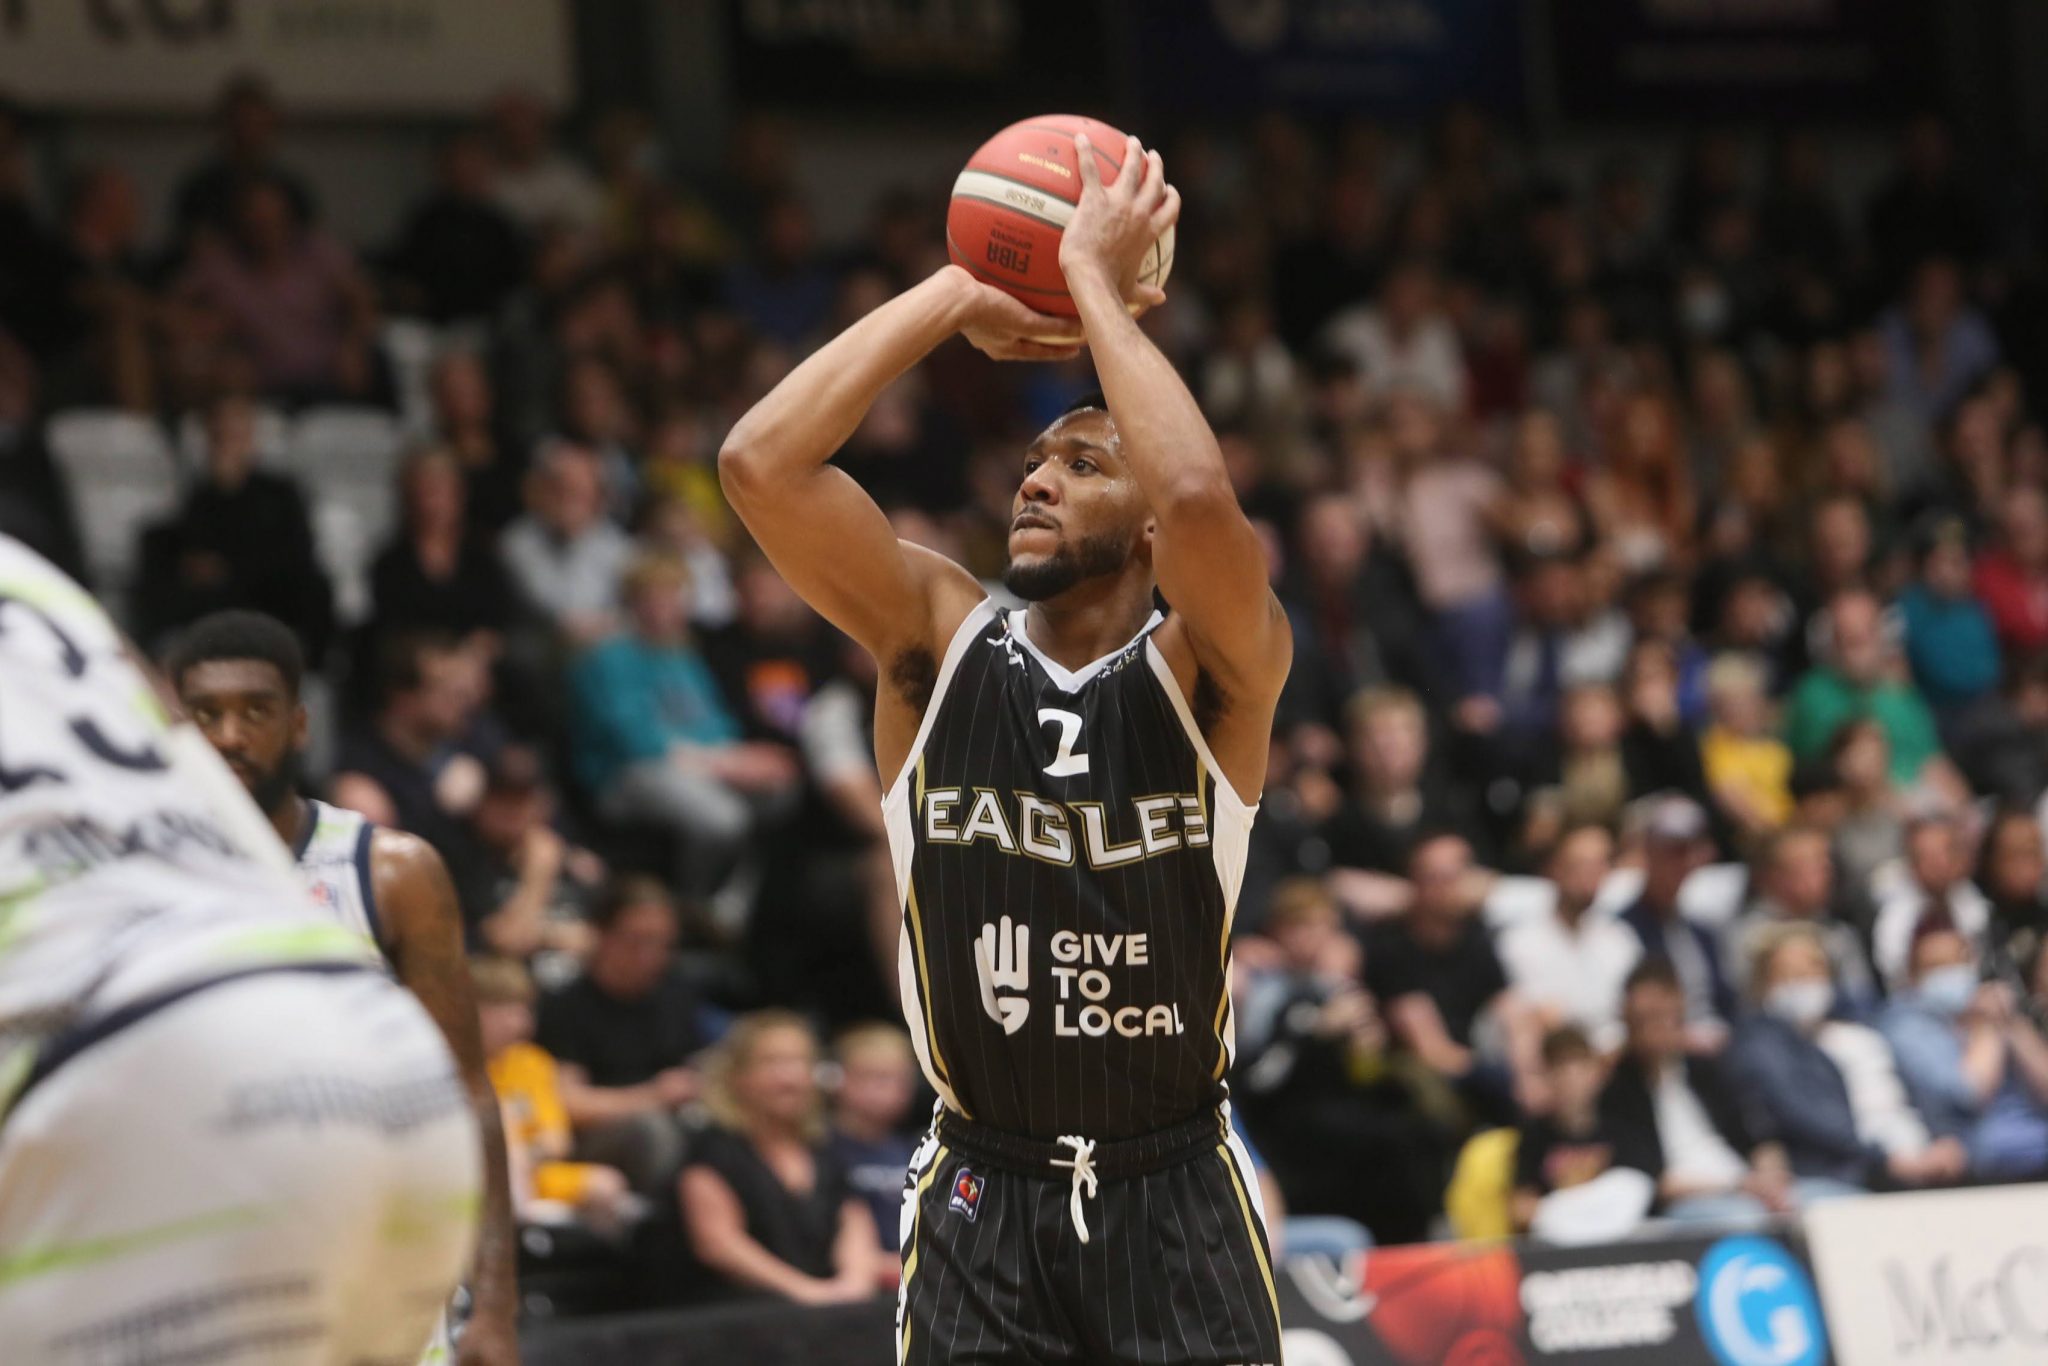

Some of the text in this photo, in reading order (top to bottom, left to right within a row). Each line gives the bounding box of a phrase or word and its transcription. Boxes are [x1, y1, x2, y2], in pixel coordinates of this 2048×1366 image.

[986, 240, 1031, 275] FIBA
[1037, 708, 1090, 777] 2
[923, 786, 1211, 870] EAGLES
[1050, 930, 1149, 966] GIVE
[1051, 966, 1111, 1001] TO
[1055, 1002, 1185, 1038] LOCAL
